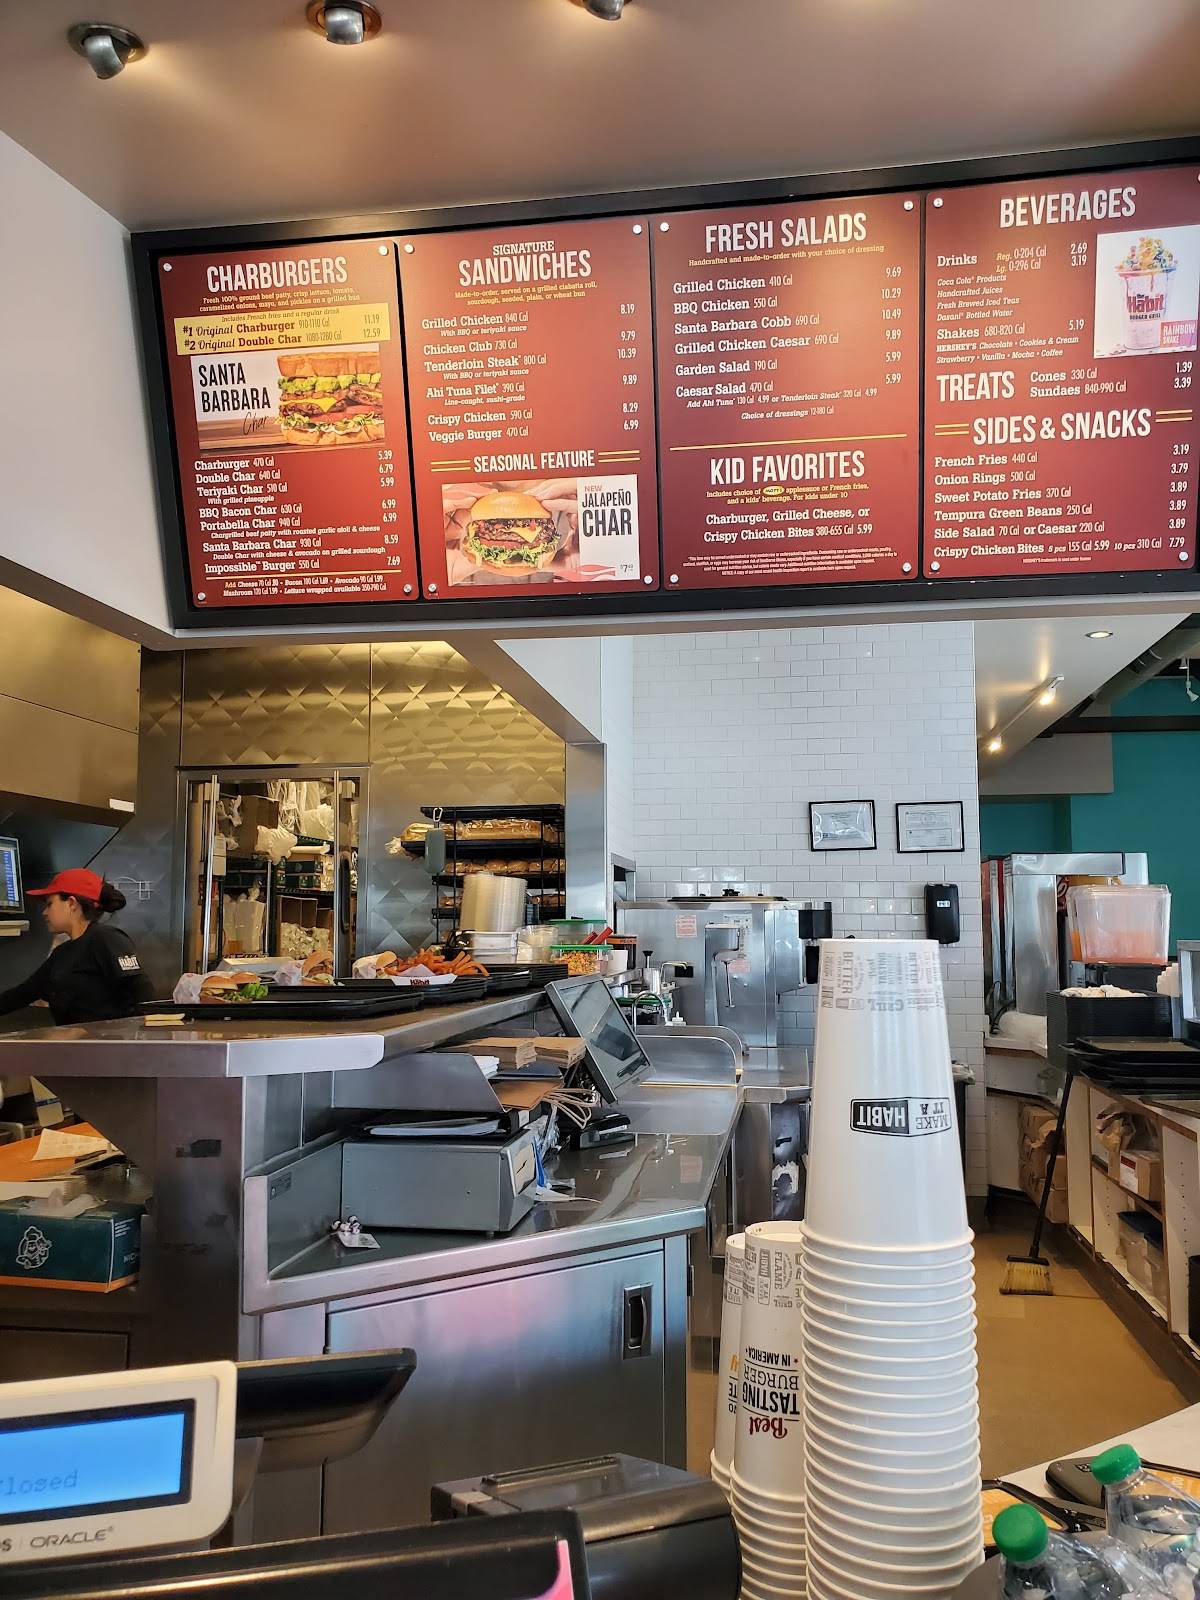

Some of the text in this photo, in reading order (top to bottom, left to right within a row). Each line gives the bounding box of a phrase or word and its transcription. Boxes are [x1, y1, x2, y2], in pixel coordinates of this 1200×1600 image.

[1000, 187, 1136, 228] BEVERAGES
[706, 213, 867, 253] FRESH SALADS
[493, 241, 554, 255] SIGNATURE
[937, 242, 1087, 267] Drinks 2.69
[459, 250, 591, 286] SANDWICHES
[1071, 255, 1087, 266] 3.19
[207, 256, 347, 293] CHARBURGERS
[673, 267, 901, 294] Grilled Chicken 9.69
[674, 288, 901, 314] BBQ Chicken 10.29
[422, 304, 634, 329] Grilled Chicken 8.19
[675, 309, 901, 334] Santa Barbara Cobb 10.49
[183, 325, 193, 337] #1
[196, 325, 233, 337] Original
[237, 323, 295, 333] Charburger
[184, 328, 380, 351] #2 Original Double Char 12.59
[937, 319, 1084, 340] Shakes 5.19
[424, 330, 635, 355] Chicken Club 9.79
[675, 330, 901, 354] Grilled Chicken Caesar 9.89
[424, 348, 636, 372] Tenderloin 10.39
[676, 351, 901, 376] Garden Salad 5.99
[1030, 361, 1192, 382] Cones 1.39
[199, 363, 246, 387] SANTA
[426, 374, 637, 398] Ahi Tuna 9.89
[676, 372, 901, 397] Caesar Salad 5.99
[936, 371, 1014, 402] TREATS
[1030, 377, 1191, 398] Sundaes 3.39
[201, 387, 271, 412] BARBARA
[242, 412, 268, 435] Char
[428, 402, 638, 426] Crispy Chicken 8.29
[428, 420, 638, 443] Veggie Burger 6.99
[973, 408, 1151, 445] SIDES & SNACKS
[194, 450, 392, 471] Charburger 5.39
[474, 448, 595, 472] SEASONAL FEATURE
[935, 444, 1189, 467] French Fries 3.19
[196, 464, 393, 483] Double Char 6.79
[711, 450, 864, 485] KID FAVORITES
[935, 463, 1188, 485] Onion Rings 3.79
[197, 477, 394, 497] Teriyaki Char 5.99
[582, 489, 631, 508] JALAPEÑO
[934, 481, 1187, 503] Sweet Potato Fries 3.89
[199, 499, 396, 518] BBQ Bacon Char 6.99
[706, 508, 870, 525] Charburger, Grilled Cheese, or
[934, 500, 1186, 522] Tempura Green Beans 3.89
[200, 512, 397, 531] Portabella Char 6.99
[583, 508, 632, 537] CHAR
[934, 518, 1185, 539] Side Salad or Caesar 3.89
[203, 534, 398, 552] Santa Barbara Char 8.59
[704, 524, 872, 543] Crispy Chicken Bites 5.99
[934, 537, 1185, 557] Crispy Chicken Bites 5.99 7.79
[262, 556, 400, 572] Burger 7.69
[856, 1105, 906, 1128] HABIT
[920, 1103, 944, 1115] IT A
[916, 1114, 950, 1130] MAKE
[744, 1364, 799, 1390] BURGER
[742, 1382, 800, 1415] TASTING
